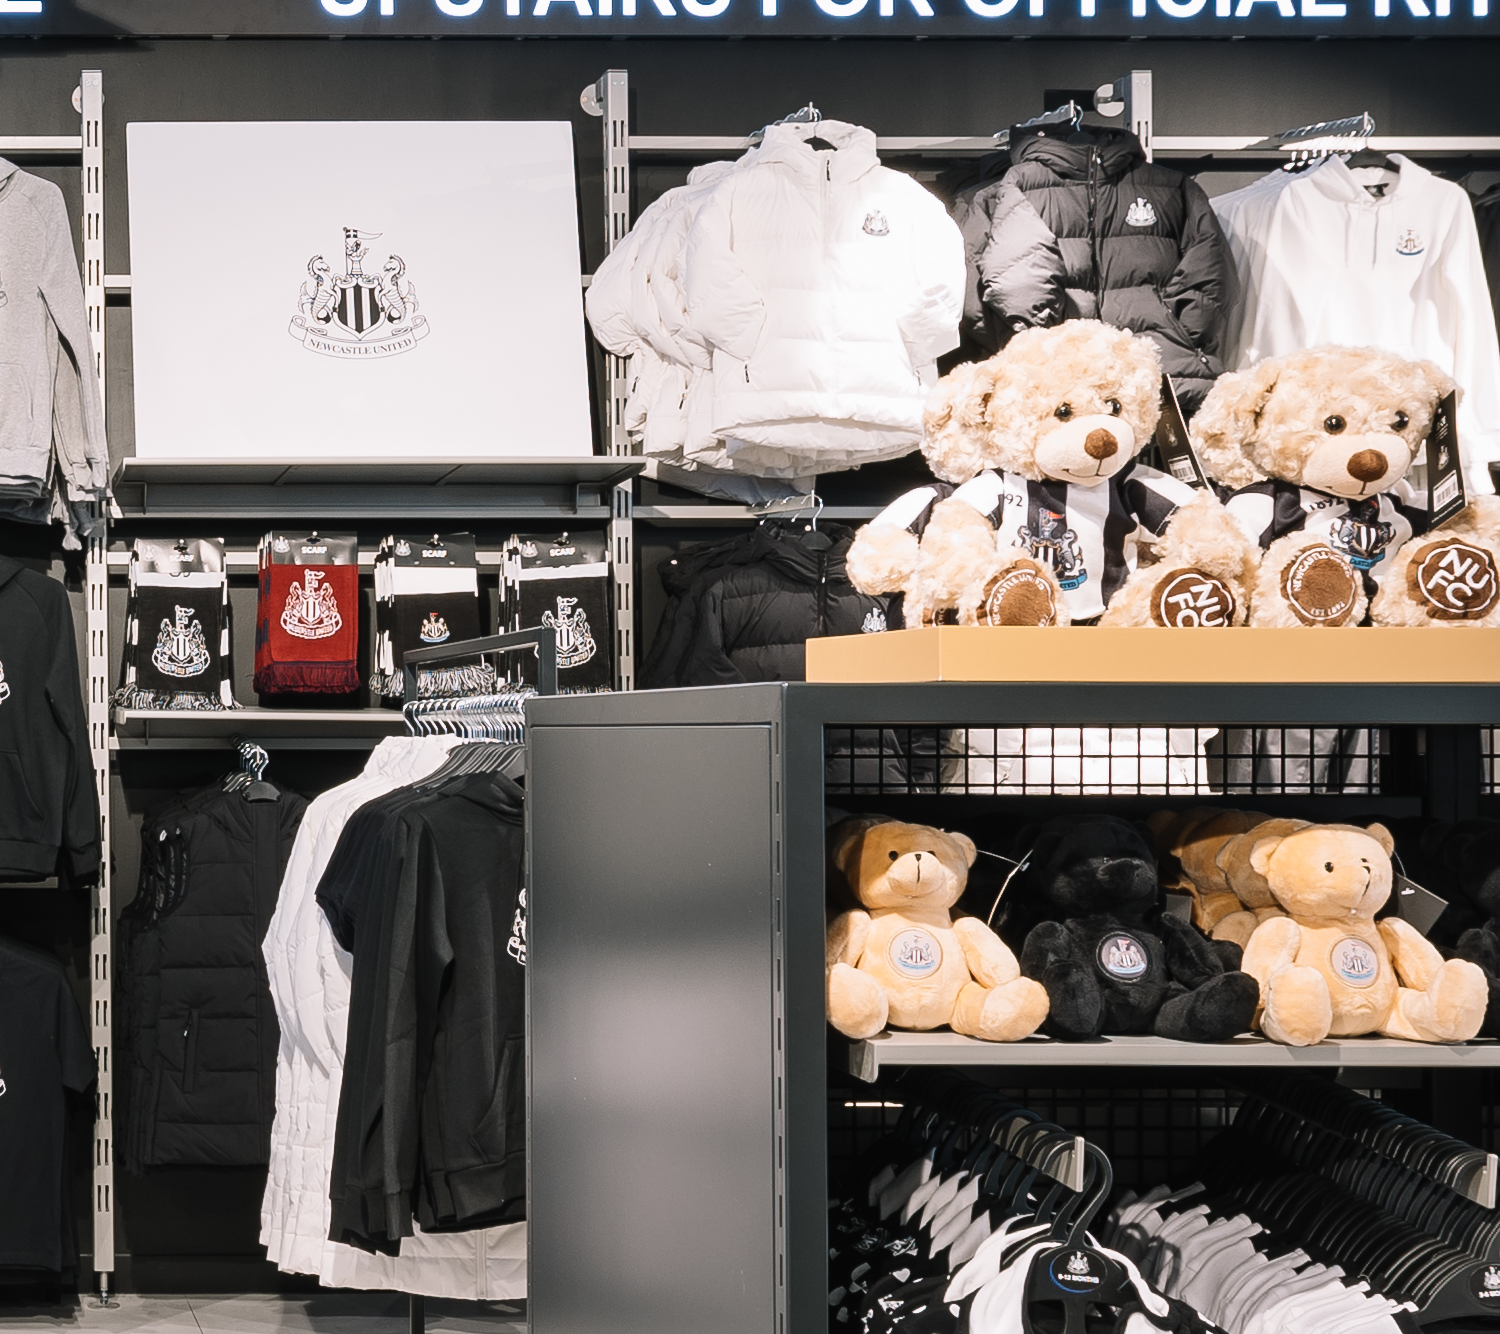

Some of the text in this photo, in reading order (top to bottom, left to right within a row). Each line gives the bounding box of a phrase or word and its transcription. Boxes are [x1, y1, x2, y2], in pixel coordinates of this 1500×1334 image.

[308, 338, 412, 354] NEWCASTLE UNITED
[1004, 493, 1023, 507] 92
[301, 545, 327, 555] SCARF
[421, 548, 448, 558] SCARF
[549, 547, 576, 557] SCARF
